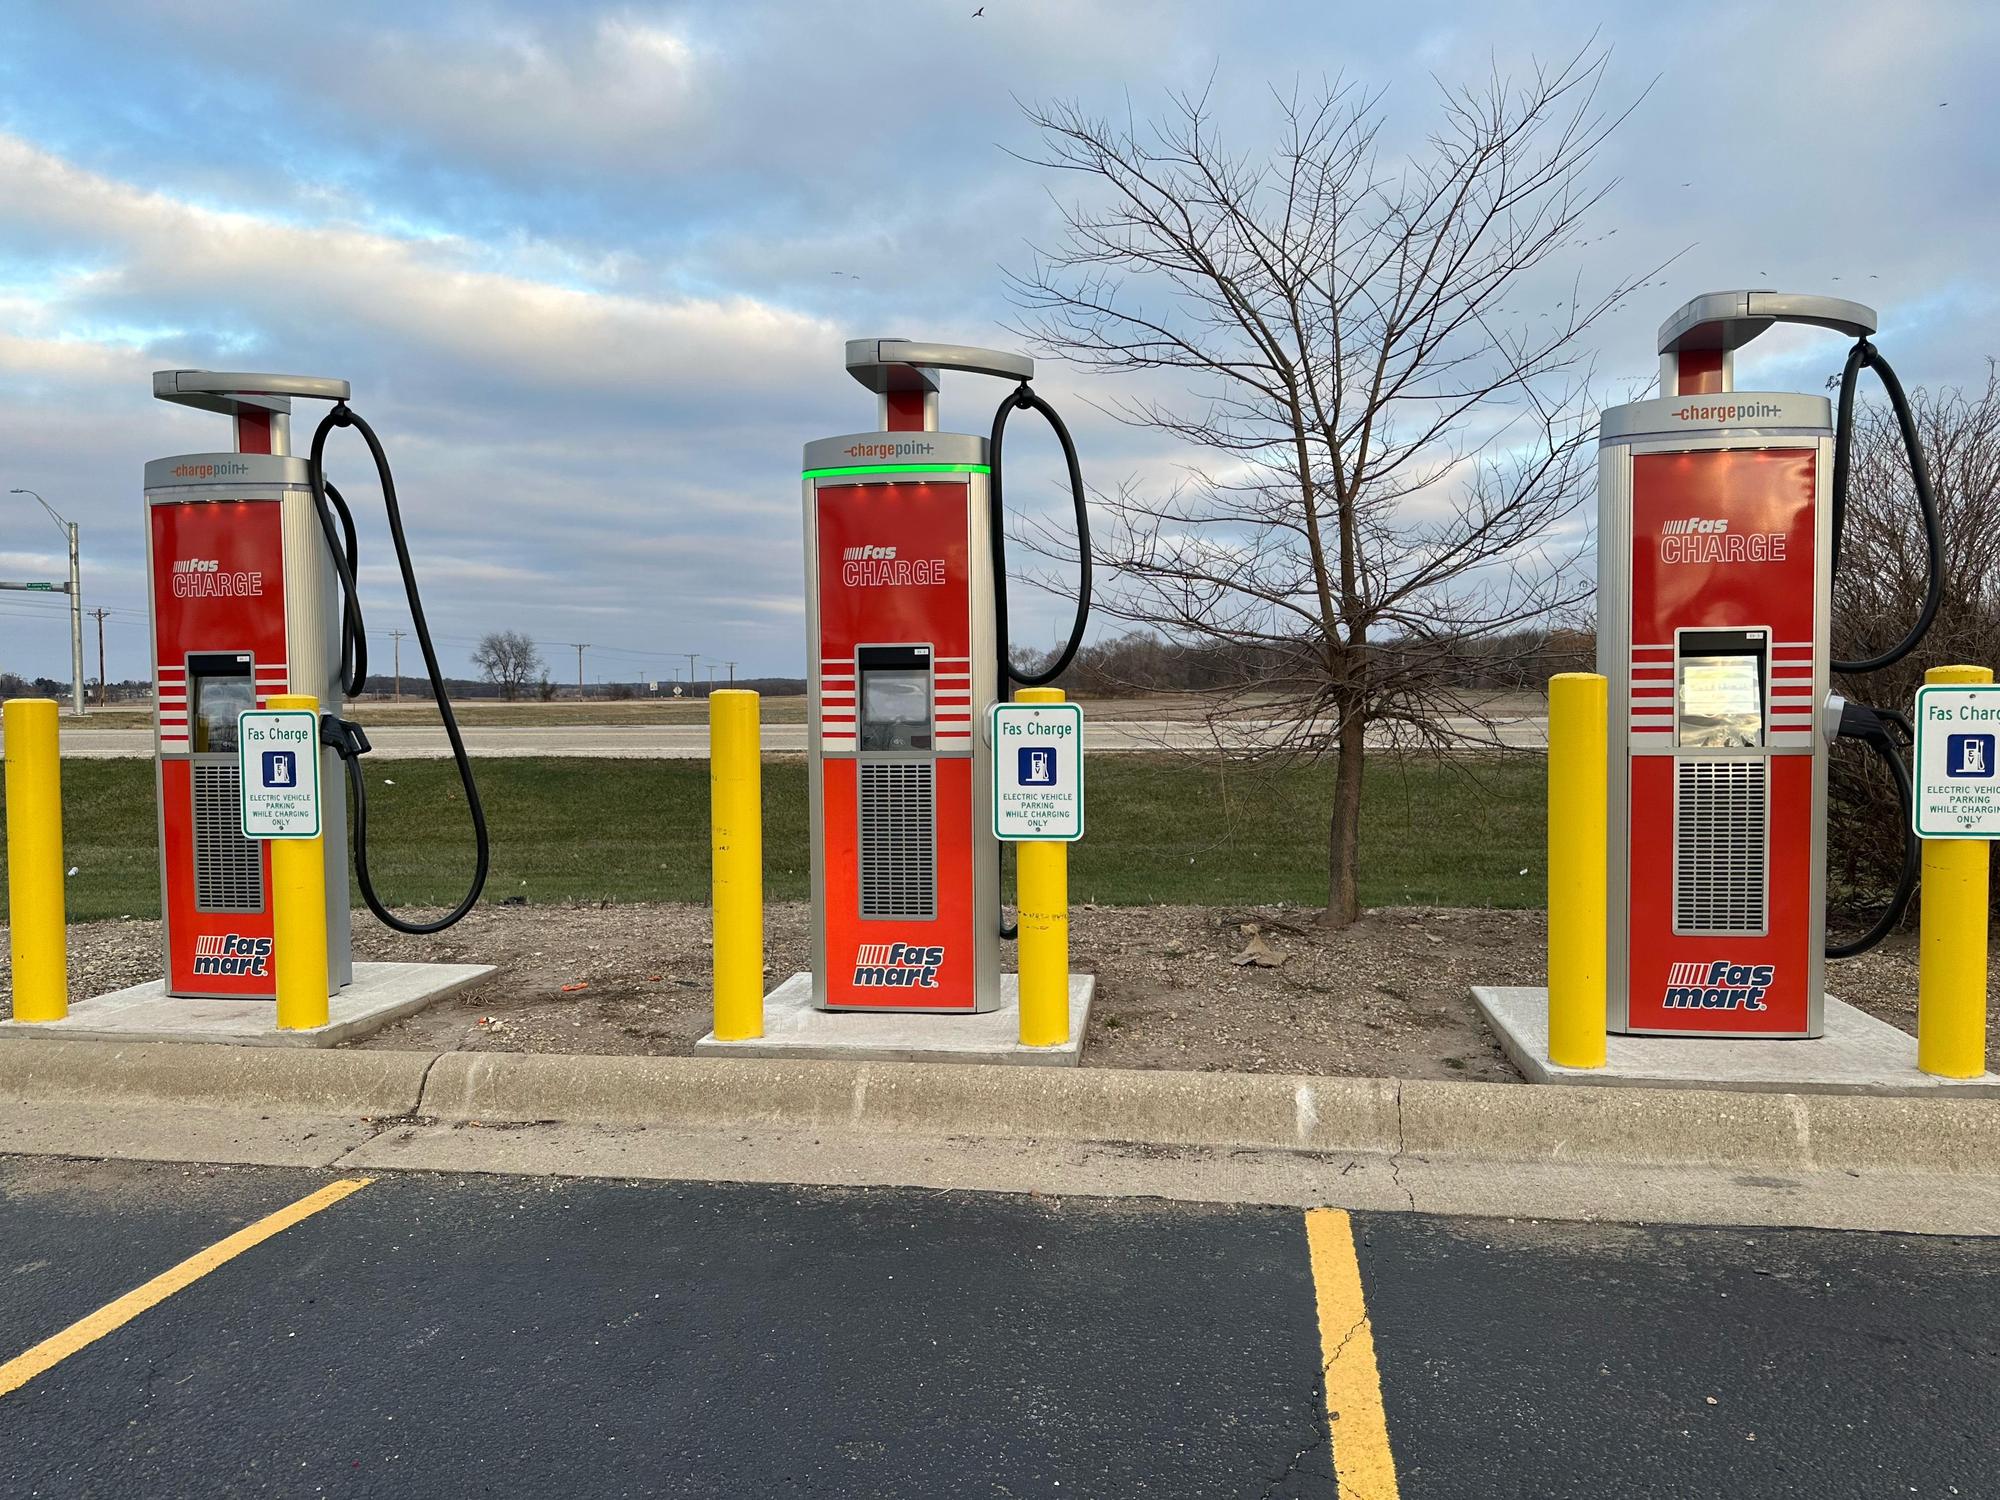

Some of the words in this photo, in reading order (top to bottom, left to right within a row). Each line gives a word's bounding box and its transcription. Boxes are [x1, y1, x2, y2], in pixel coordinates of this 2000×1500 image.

[1661, 534, 1786, 564] CHARGE
[843, 560, 946, 587] CHARGE
[173, 572, 263, 598] CHARGE
[1929, 706, 1953, 721] Fas
[248, 728, 265, 740] Fas
[269, 728, 308, 743] Charge
[1003, 722, 1022, 735] Fas
[1027, 722, 1072, 739] Charge
[1927, 786, 1970, 794] ELECTRIC
[250, 794, 281, 802] ELECTRIC
[1950, 796, 1990, 804] PARKING
